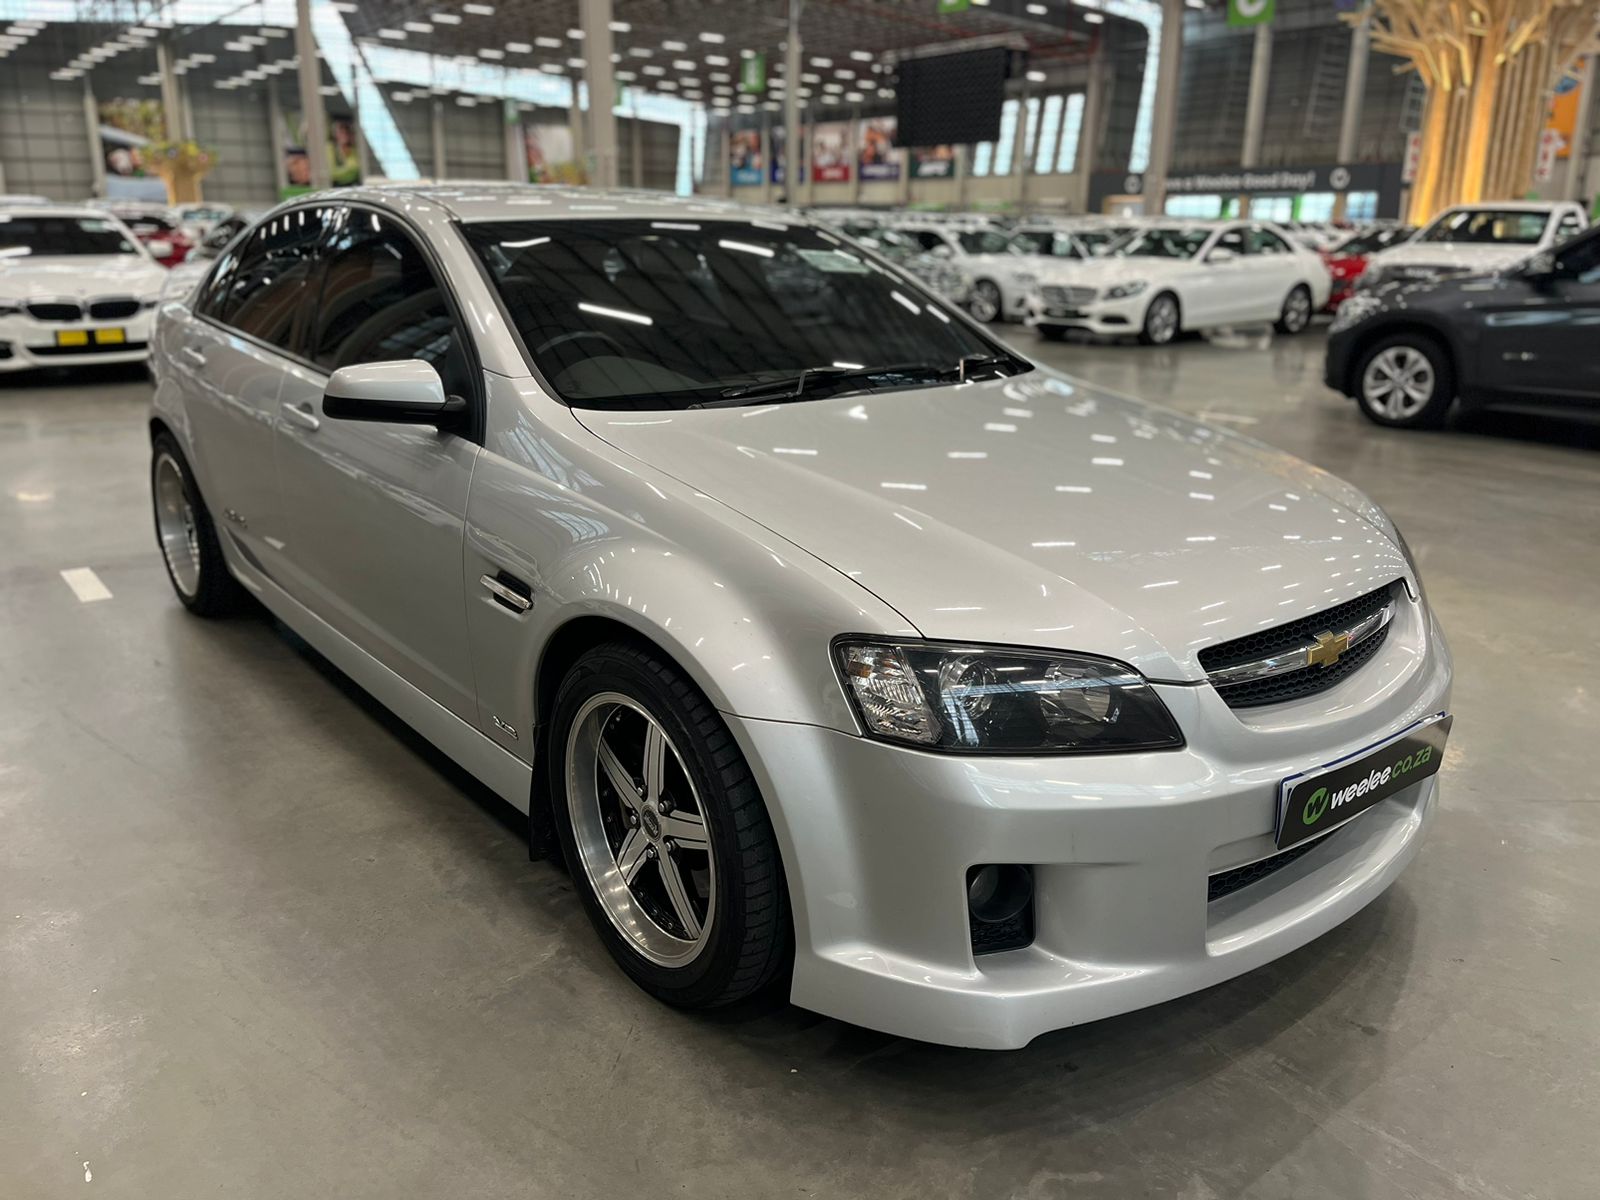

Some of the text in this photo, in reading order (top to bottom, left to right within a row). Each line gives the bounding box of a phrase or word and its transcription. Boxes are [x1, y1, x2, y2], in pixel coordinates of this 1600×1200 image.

[1242, 172, 1279, 189] Good
[1281, 170, 1316, 191] Day!
[1331, 745, 1432, 809] weelee.co.za
